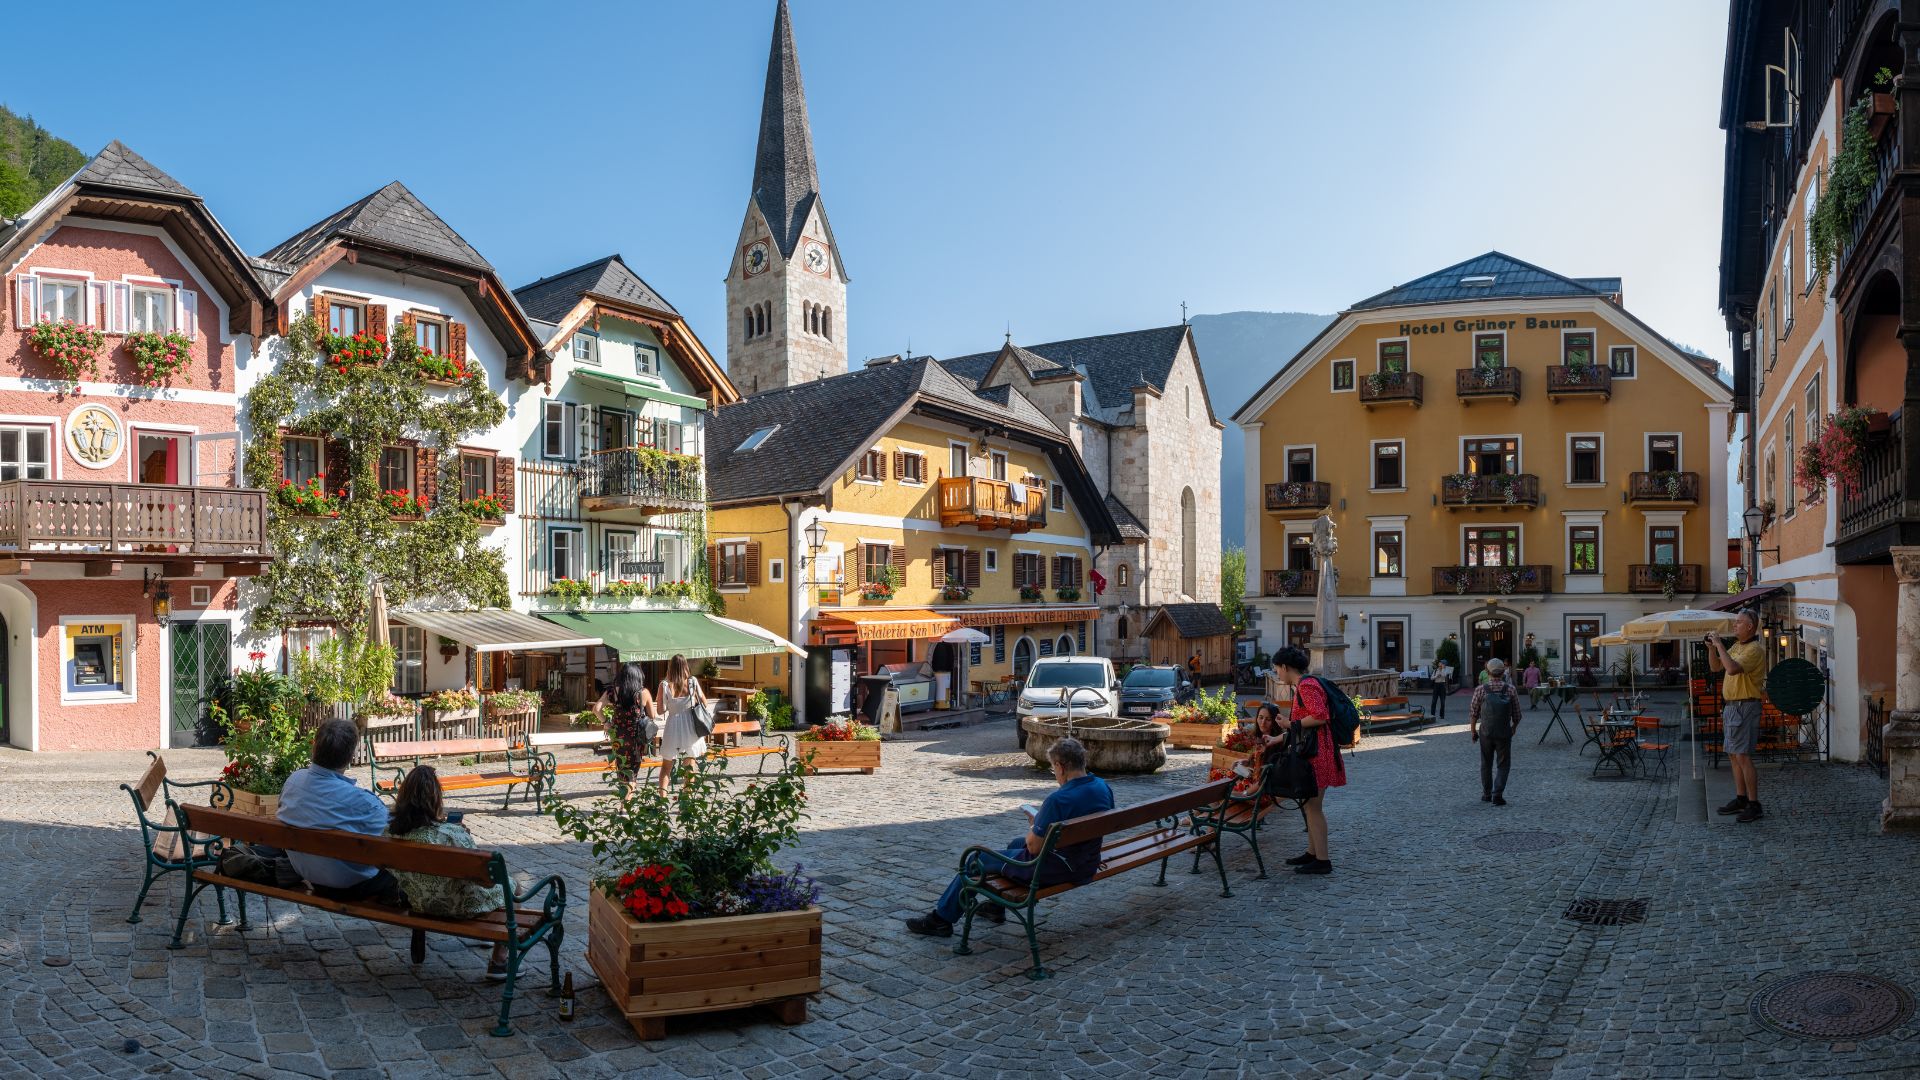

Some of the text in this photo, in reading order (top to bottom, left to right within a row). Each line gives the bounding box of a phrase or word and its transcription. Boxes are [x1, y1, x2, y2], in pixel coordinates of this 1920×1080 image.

[1400, 317, 1577, 336] Hotel Grüner Baum
[81, 624, 105, 634] ATM
[860, 625, 906, 639] Gelateria
[910, 624, 927, 637] San
[630, 652, 649, 662] Hotel
